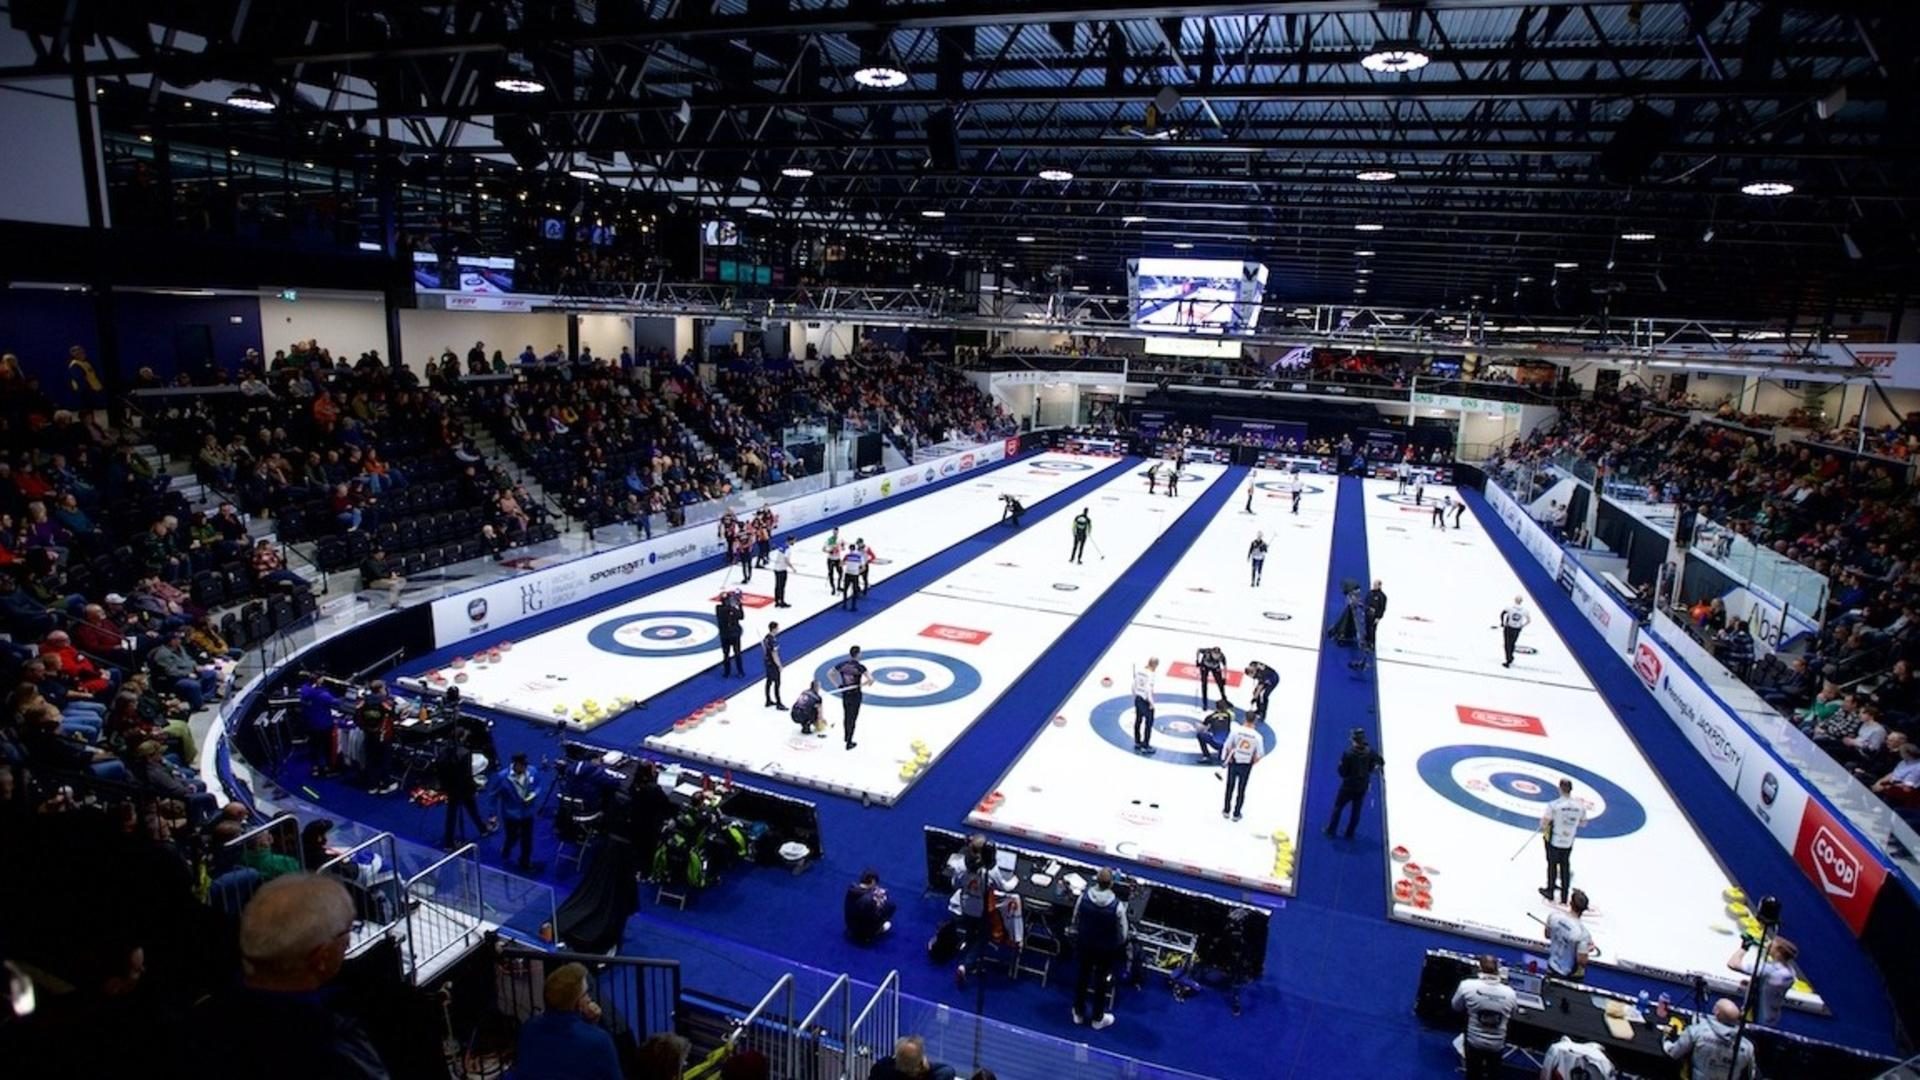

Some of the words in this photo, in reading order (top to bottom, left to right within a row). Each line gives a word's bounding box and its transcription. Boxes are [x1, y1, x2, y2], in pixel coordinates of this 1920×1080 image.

[589, 558, 645, 582] SPORTSNET
[1697, 714, 1727, 747] JACKPOT
[1724, 741, 1741, 767] CITY
[1816, 837, 1854, 884] CO-OP
[1411, 914, 1467, 930] SPORTSNET
